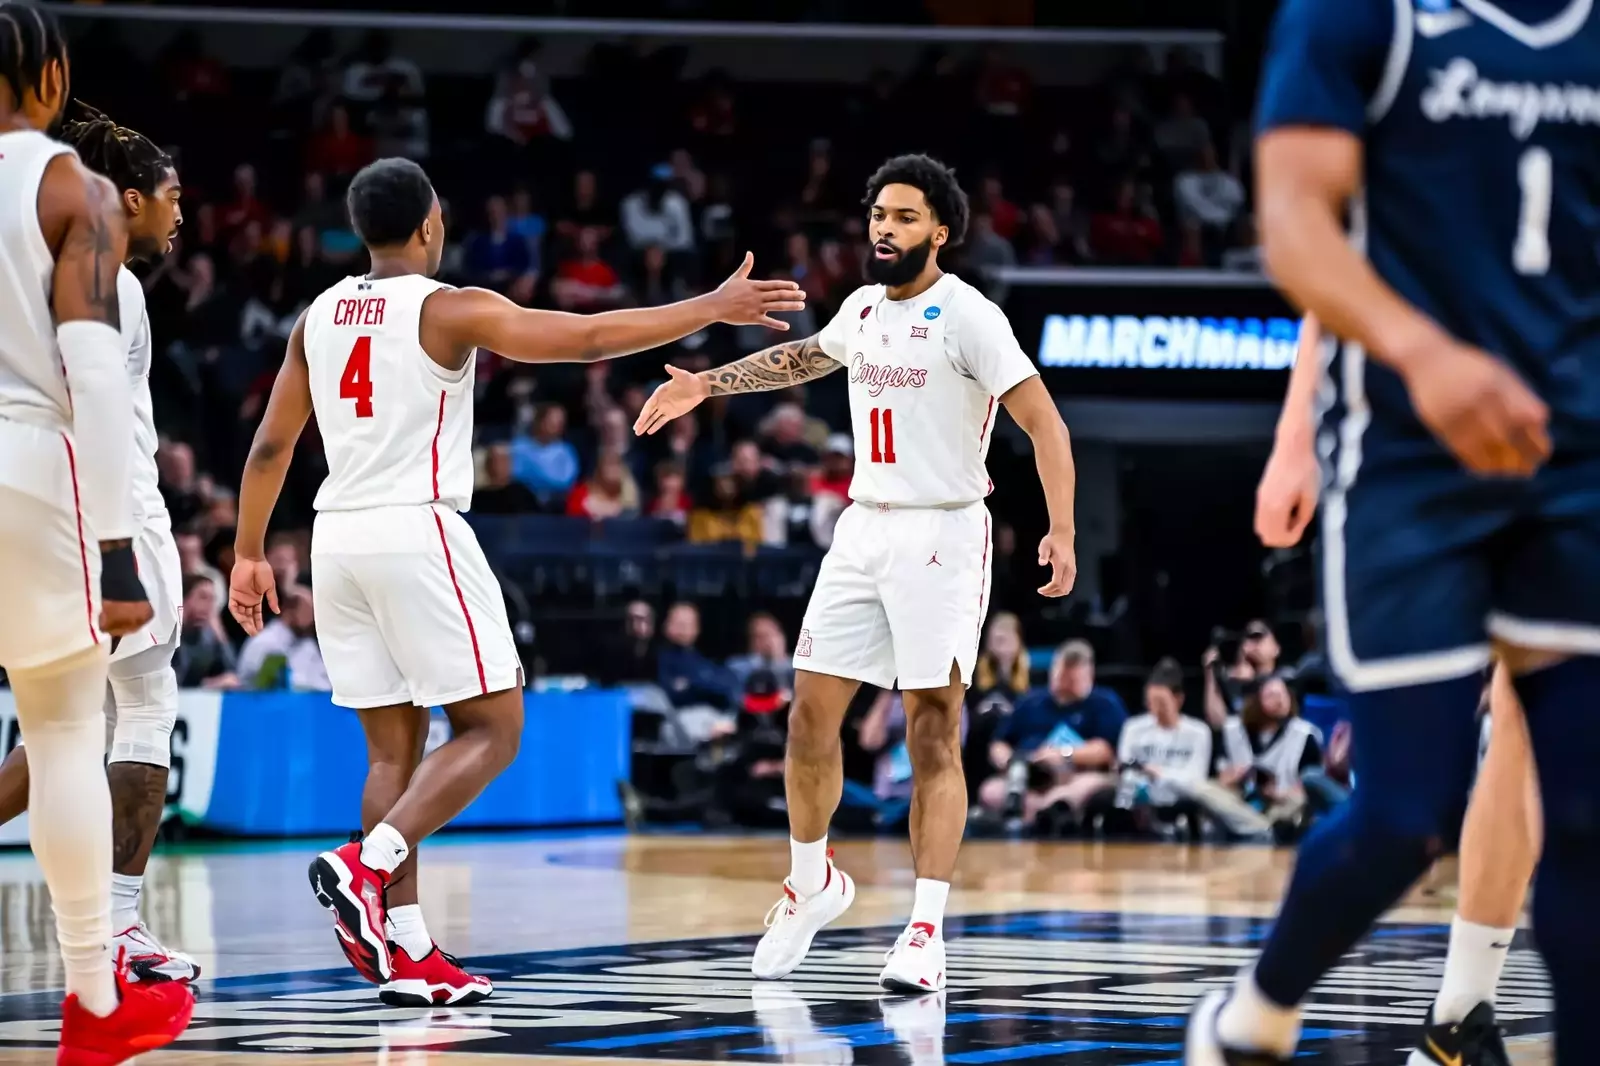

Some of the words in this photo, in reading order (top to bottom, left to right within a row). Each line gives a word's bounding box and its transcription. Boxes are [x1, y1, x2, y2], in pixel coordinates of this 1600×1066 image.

[1512, 146, 1553, 276] 1
[334, 298, 386, 325] CRYER
[1039, 315, 1302, 369] MARCHMAD
[340, 336, 373, 418] 4
[851, 352, 928, 398] Cougars
[870, 408, 896, 463] 11
